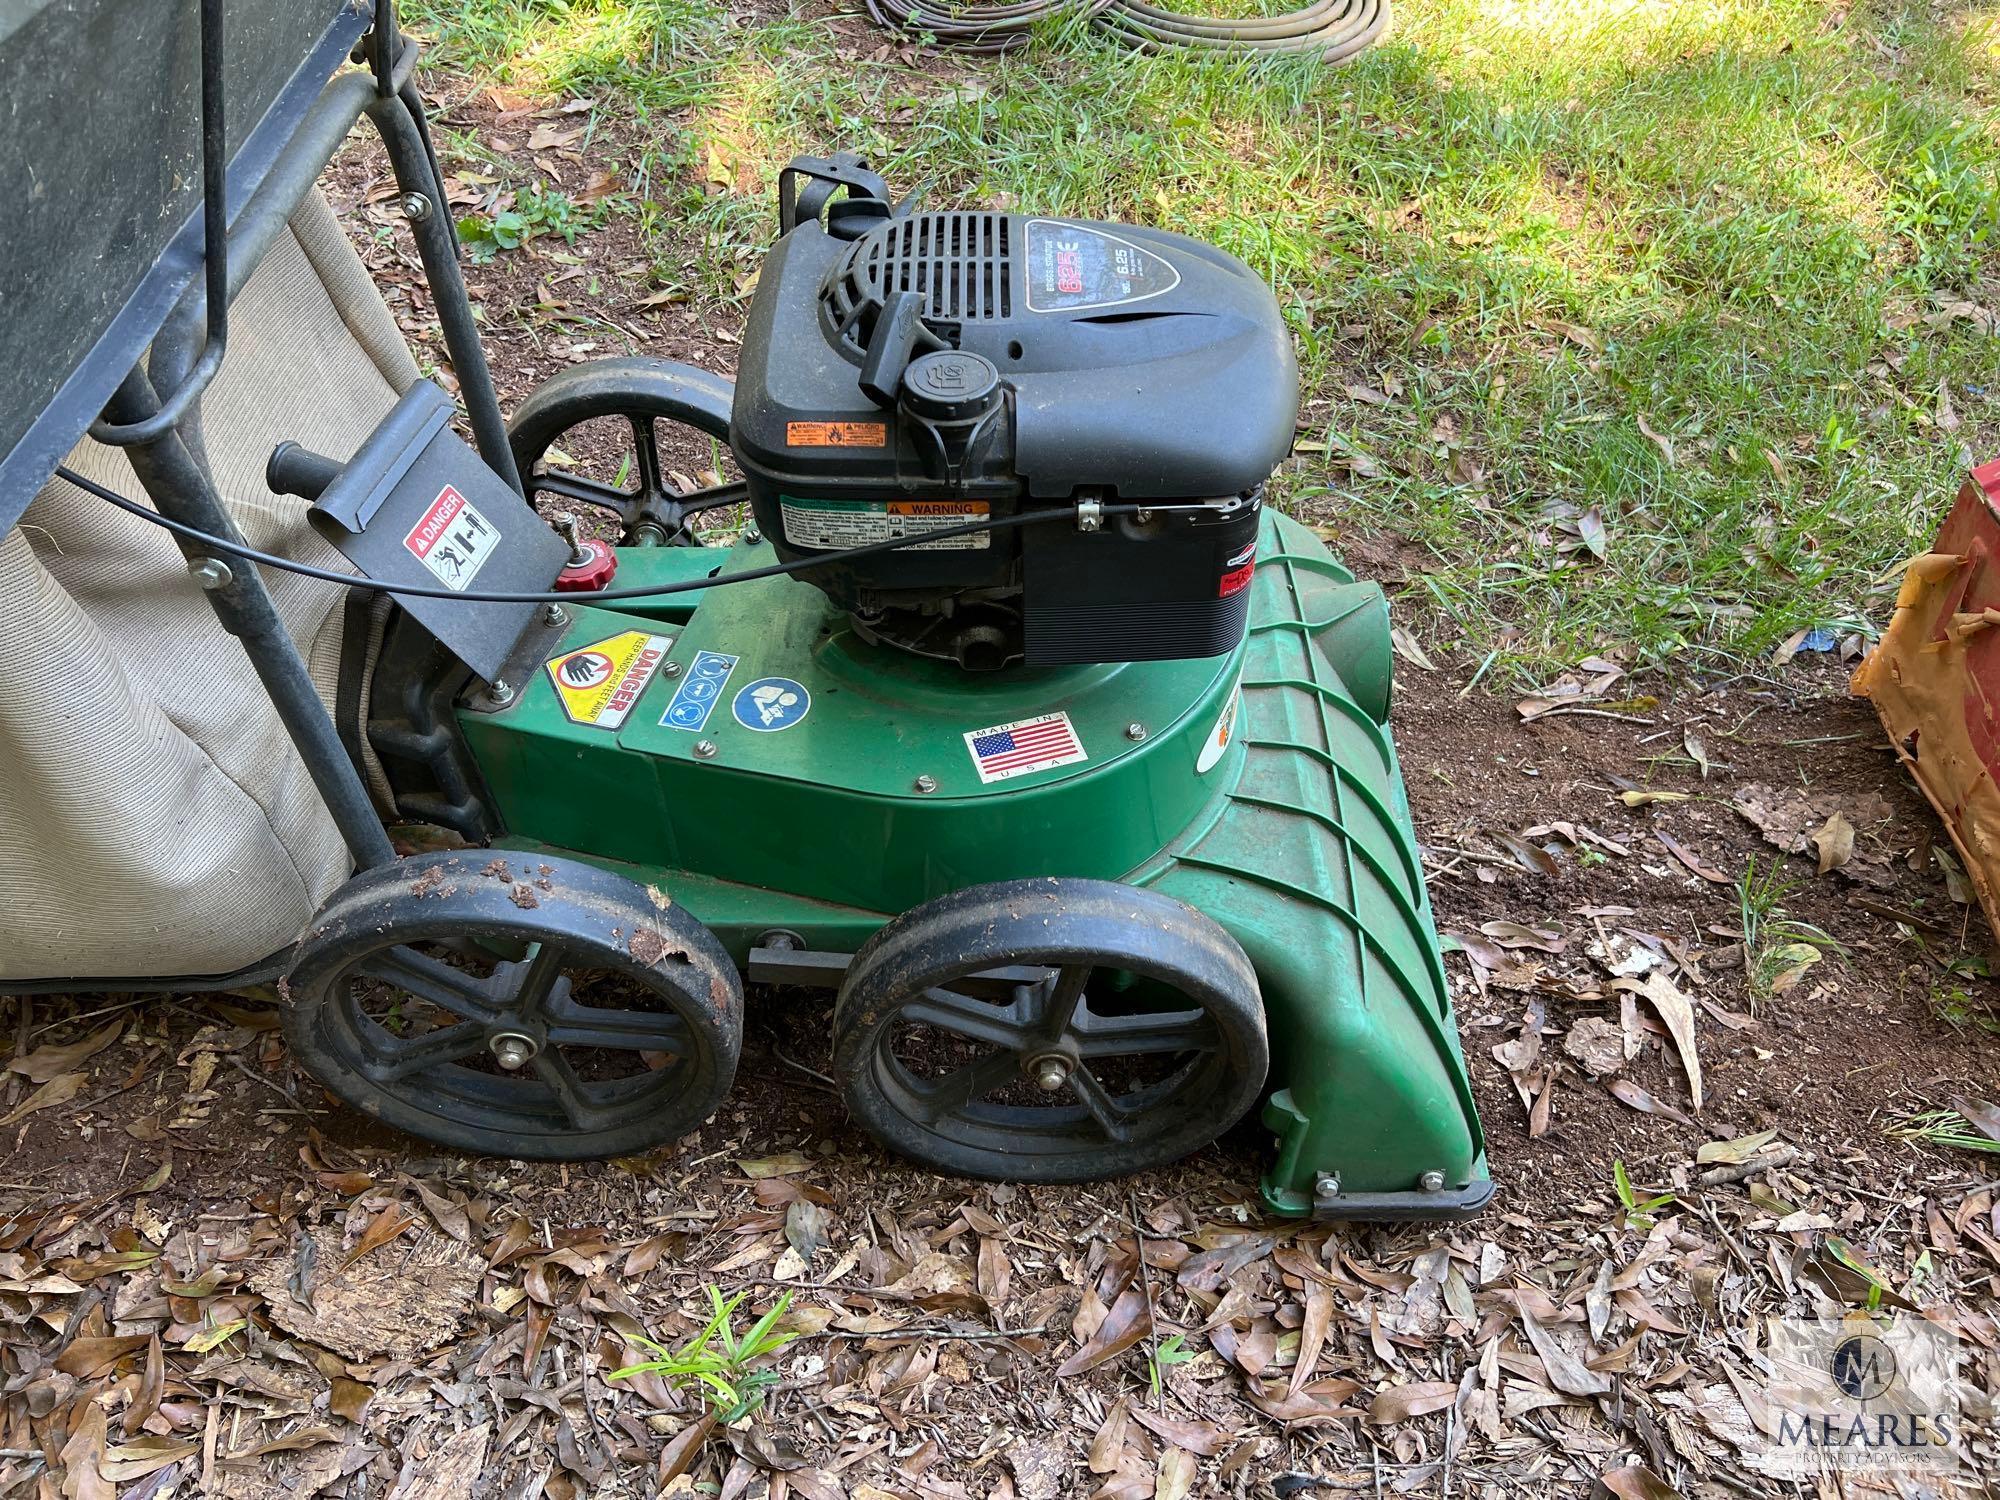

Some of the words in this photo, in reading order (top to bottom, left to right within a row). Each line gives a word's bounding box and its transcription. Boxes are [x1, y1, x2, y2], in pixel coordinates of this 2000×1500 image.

[1115, 249, 1129, 275] 6.25
[425, 494, 461, 540] DANGER
[911, 504, 973, 514] WARNING
[632, 638, 645, 653] KEEP
[617, 652, 636, 674] HANDS
[606, 649, 661, 712] DANGER
[610, 673, 621, 685] and
[601, 683, 615, 701] FEET
[588, 700, 604, 719] AWAY
[976, 722, 1021, 737] MADE
[1036, 715, 1052, 723] IN
